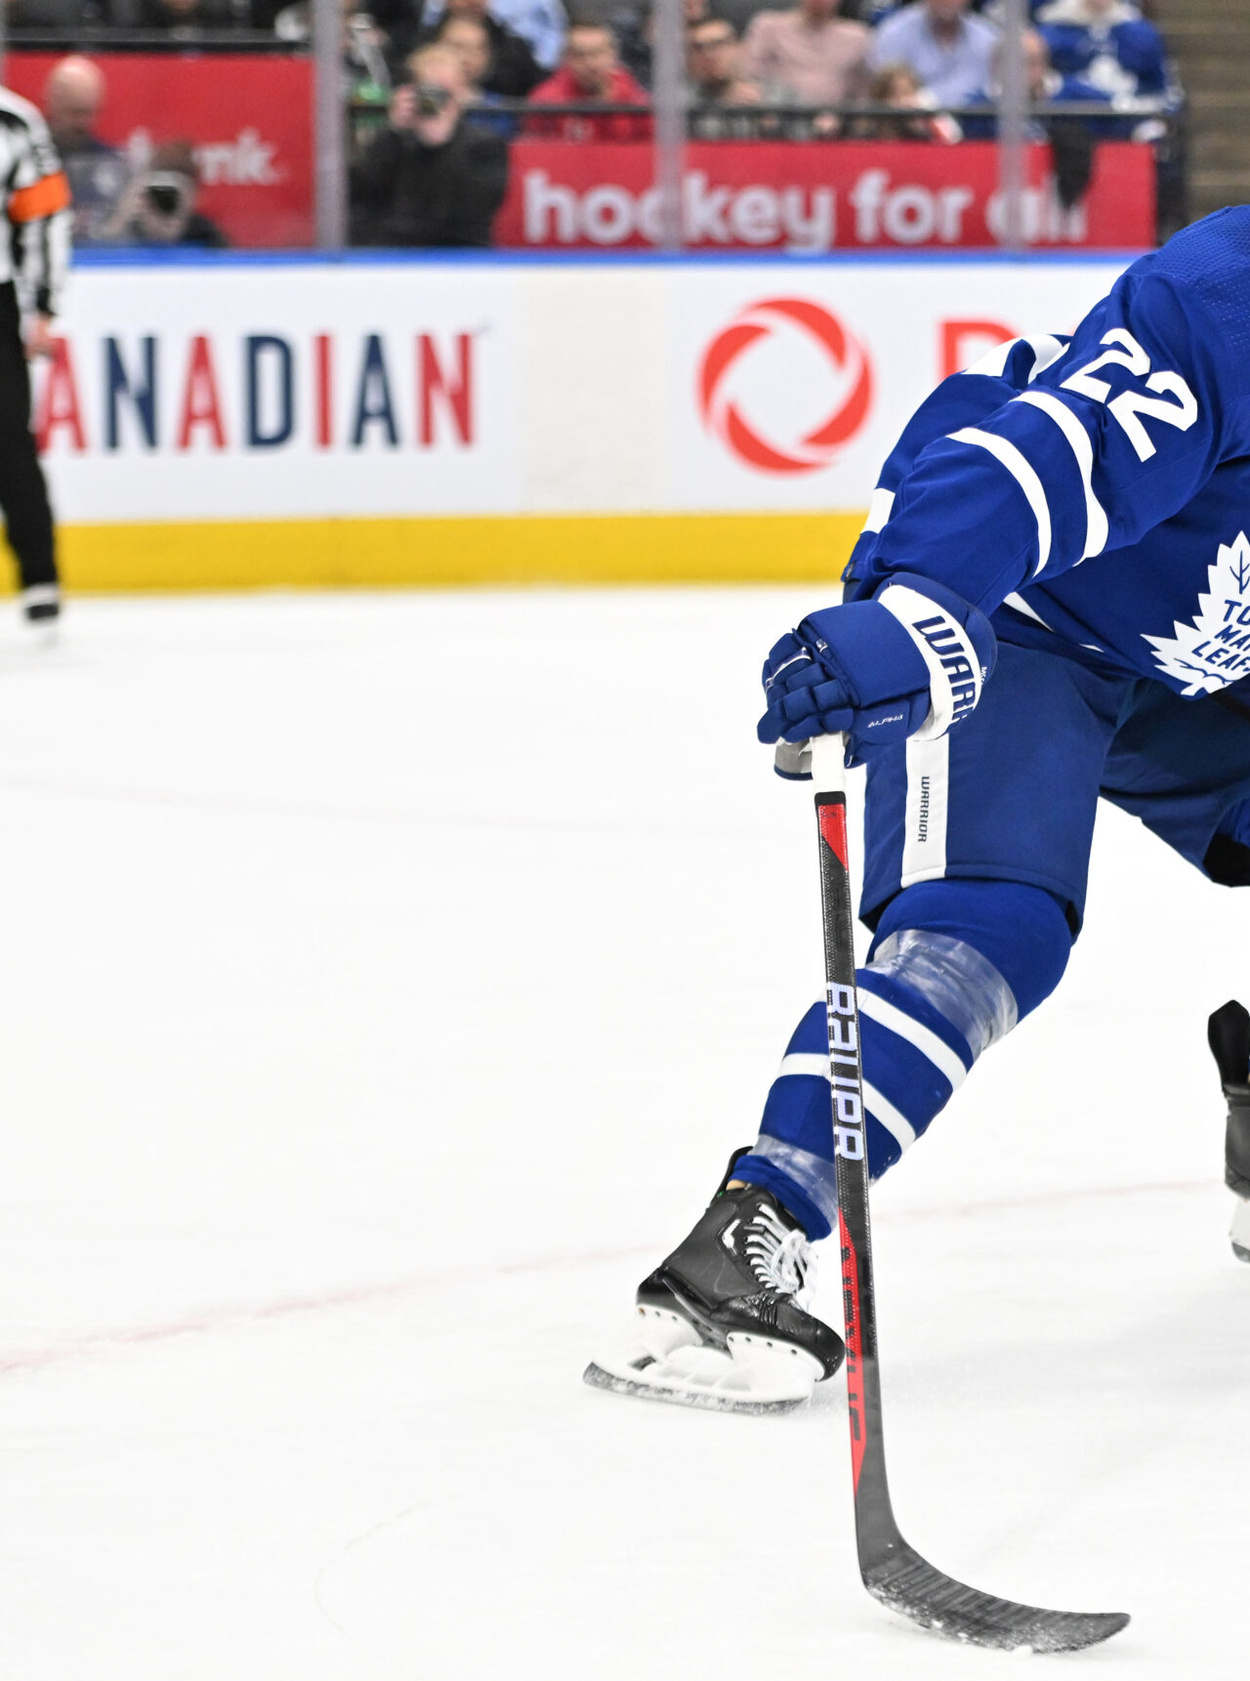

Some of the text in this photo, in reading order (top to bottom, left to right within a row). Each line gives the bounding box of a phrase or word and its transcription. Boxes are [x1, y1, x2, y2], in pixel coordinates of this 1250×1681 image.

[851, 168, 974, 243] for
[35, 334, 474, 452] ANADIAN
[1058, 327, 1199, 463] 22
[917, 775, 931, 843] WARRIOR
